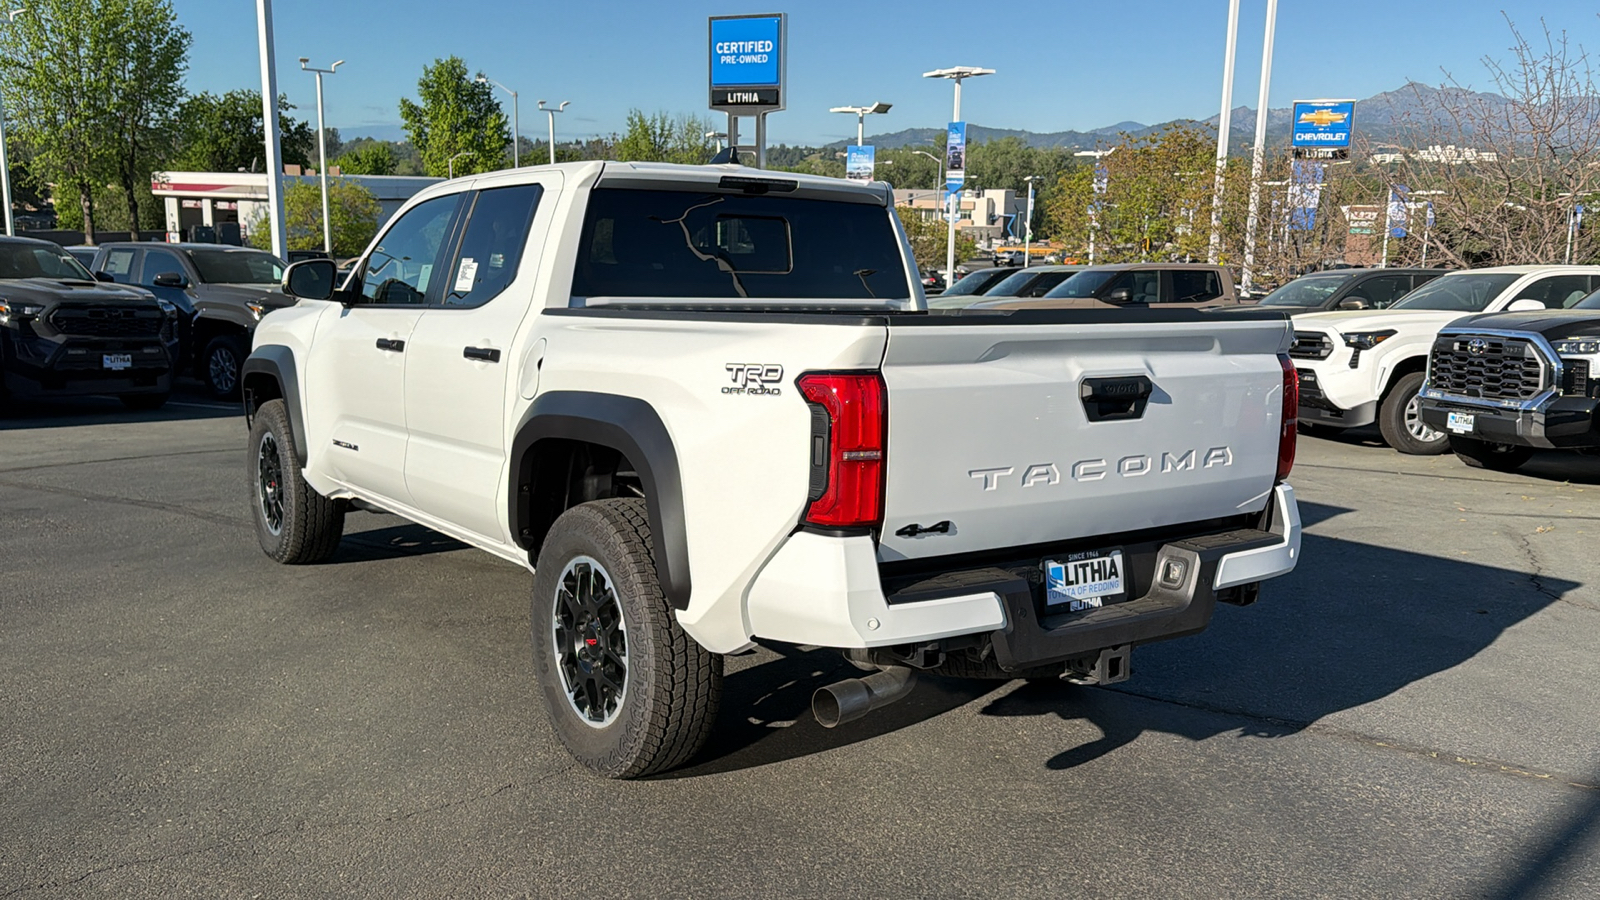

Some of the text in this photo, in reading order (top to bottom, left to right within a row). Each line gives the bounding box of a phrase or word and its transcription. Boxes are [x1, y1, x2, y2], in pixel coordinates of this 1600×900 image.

[716, 40, 773, 54] CERTIFIED
[720, 54, 769, 65] PRE-OWNED
[727, 92, 759, 103] LITHIA
[1295, 132, 1347, 141] CHEVROLET
[725, 363, 784, 388] TRD
[721, 387, 782, 396] OFF ROAD
[1105, 383, 1137, 394] TOYOTA
[967, 445, 1234, 492] TACOMA
[1068, 553, 1085, 561] SINCE
[1064, 558, 1119, 586] LITHIA
[1048, 580, 1119, 600] TOYOTA OF REDDING
